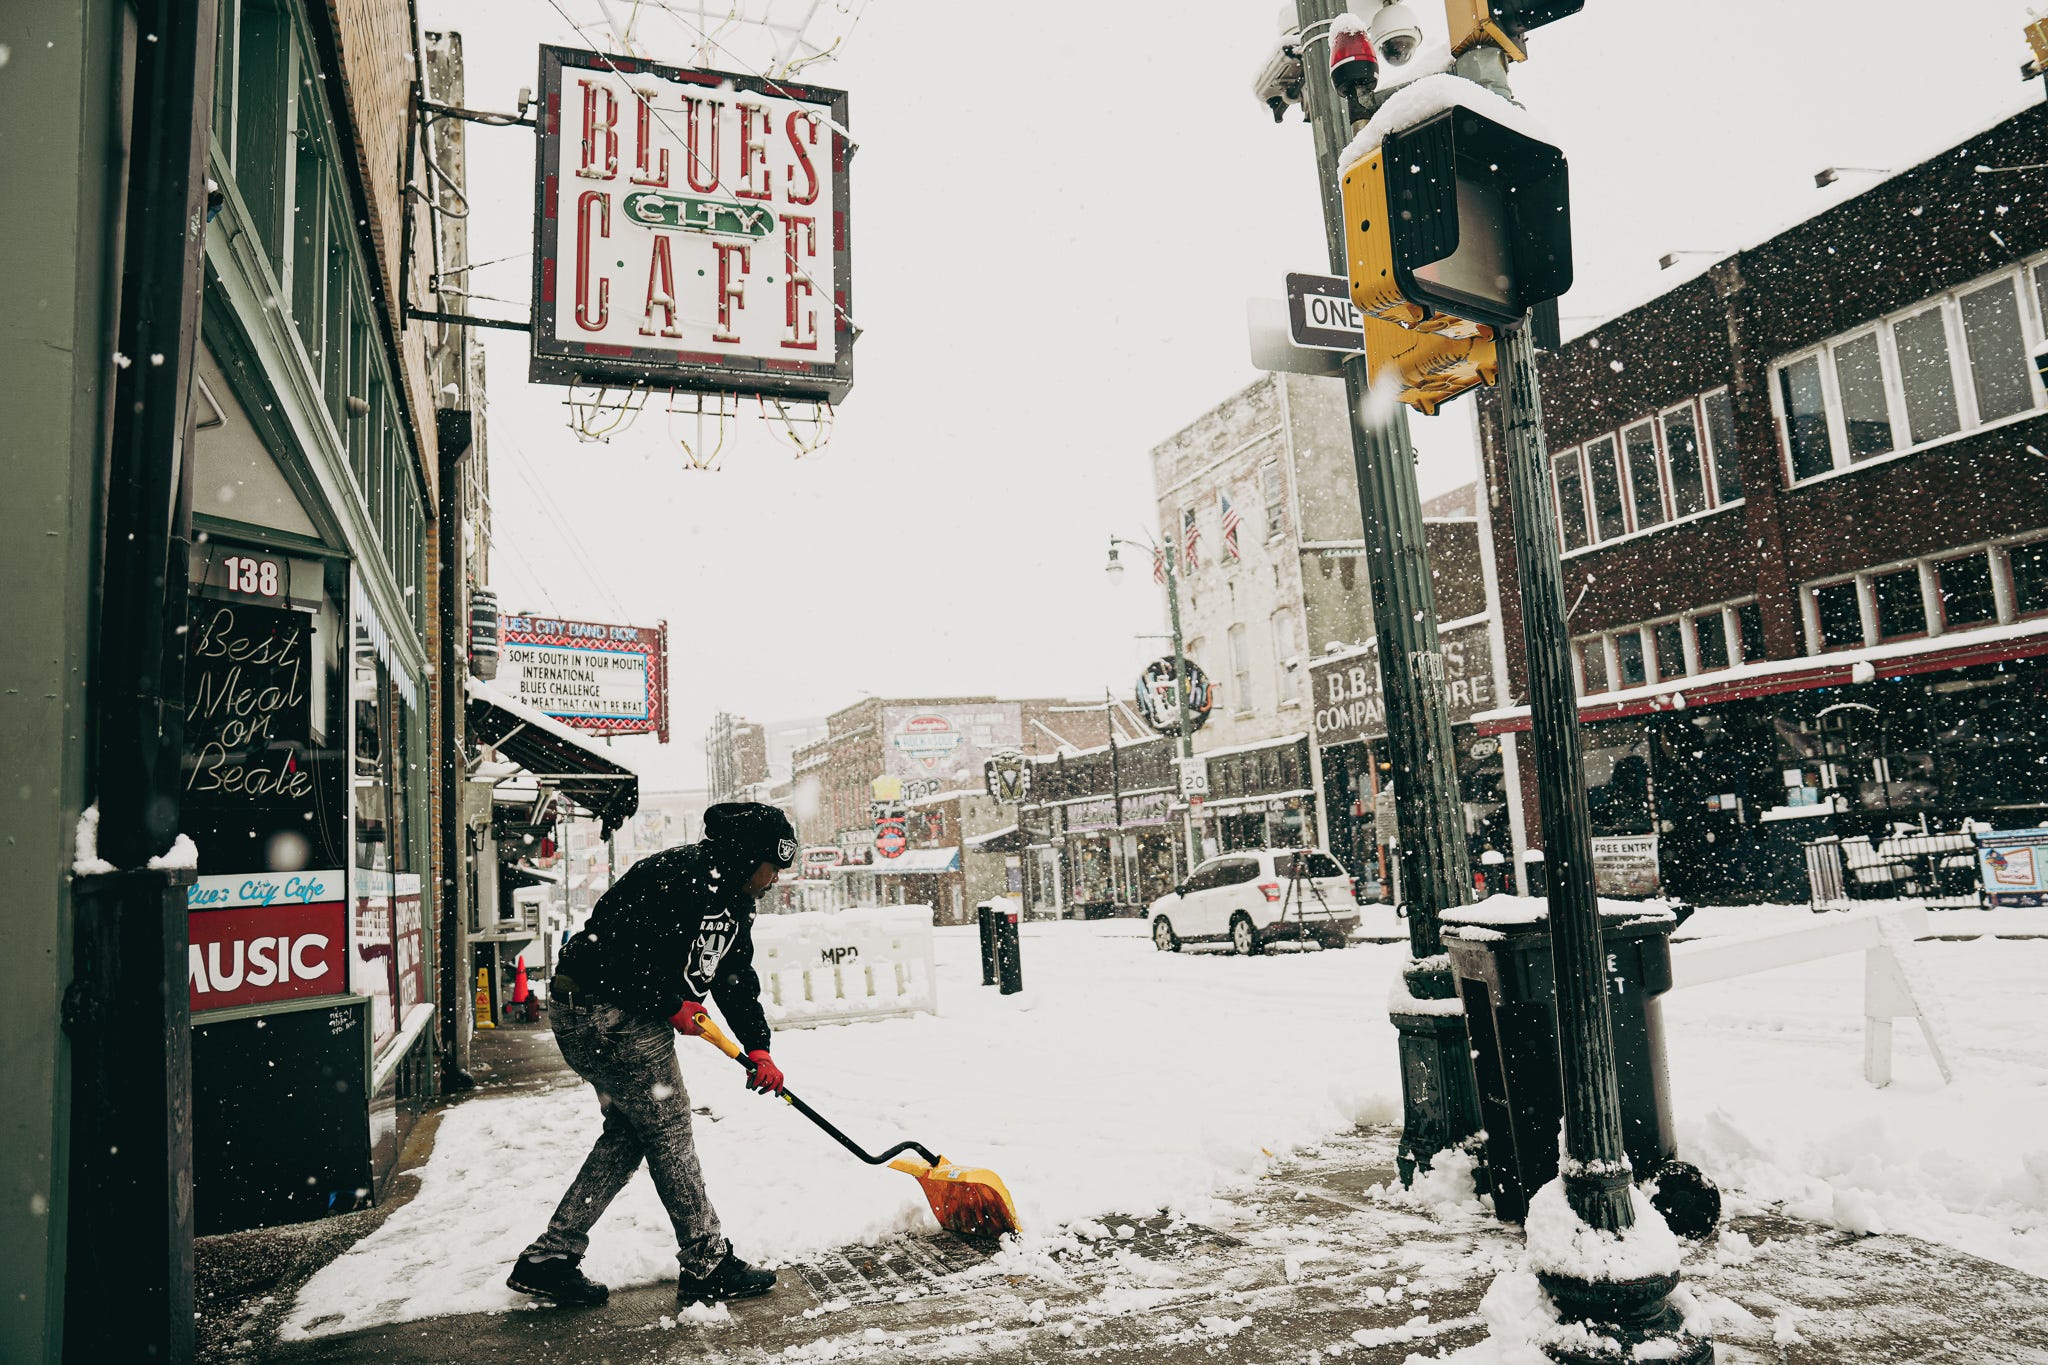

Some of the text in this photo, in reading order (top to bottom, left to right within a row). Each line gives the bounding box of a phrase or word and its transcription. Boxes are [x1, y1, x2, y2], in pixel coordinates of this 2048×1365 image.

[576, 79, 820, 206] BLUES
[635, 194, 764, 232] CITY
[575, 190, 818, 350] CAFE
[1311, 298, 1363, 328] ONE
[224, 556, 278, 597] 138
[196, 608, 299, 666] Best
[536, 619, 566, 635] CITY
[569, 623, 607, 639] BAND
[610, 626, 639, 642] BOX
[510, 650, 644, 671] SOME SOUTH IN YOUR MOUTH
[523, 666, 595, 682] INTERNATIONAL
[187, 656, 303, 721] Meal
[520, 681, 600, 697] BLUES CHALLENGE
[1326, 667, 1373, 704] B.B.
[531, 697, 554, 709] MEAT
[558, 698, 579, 710] THAT
[582, 699, 607, 712] CANT
[1316, 697, 1386, 733] COMPAN
[221, 714, 271, 747] on
[187, 742, 313, 797] Beale
[1185, 776, 1205, 790] 20
[1595, 842, 1653, 853] FREE ENTRY
[187, 883, 231, 905] lues
[239, 880, 280, 907] City
[285, 876, 325, 905] Cafe
